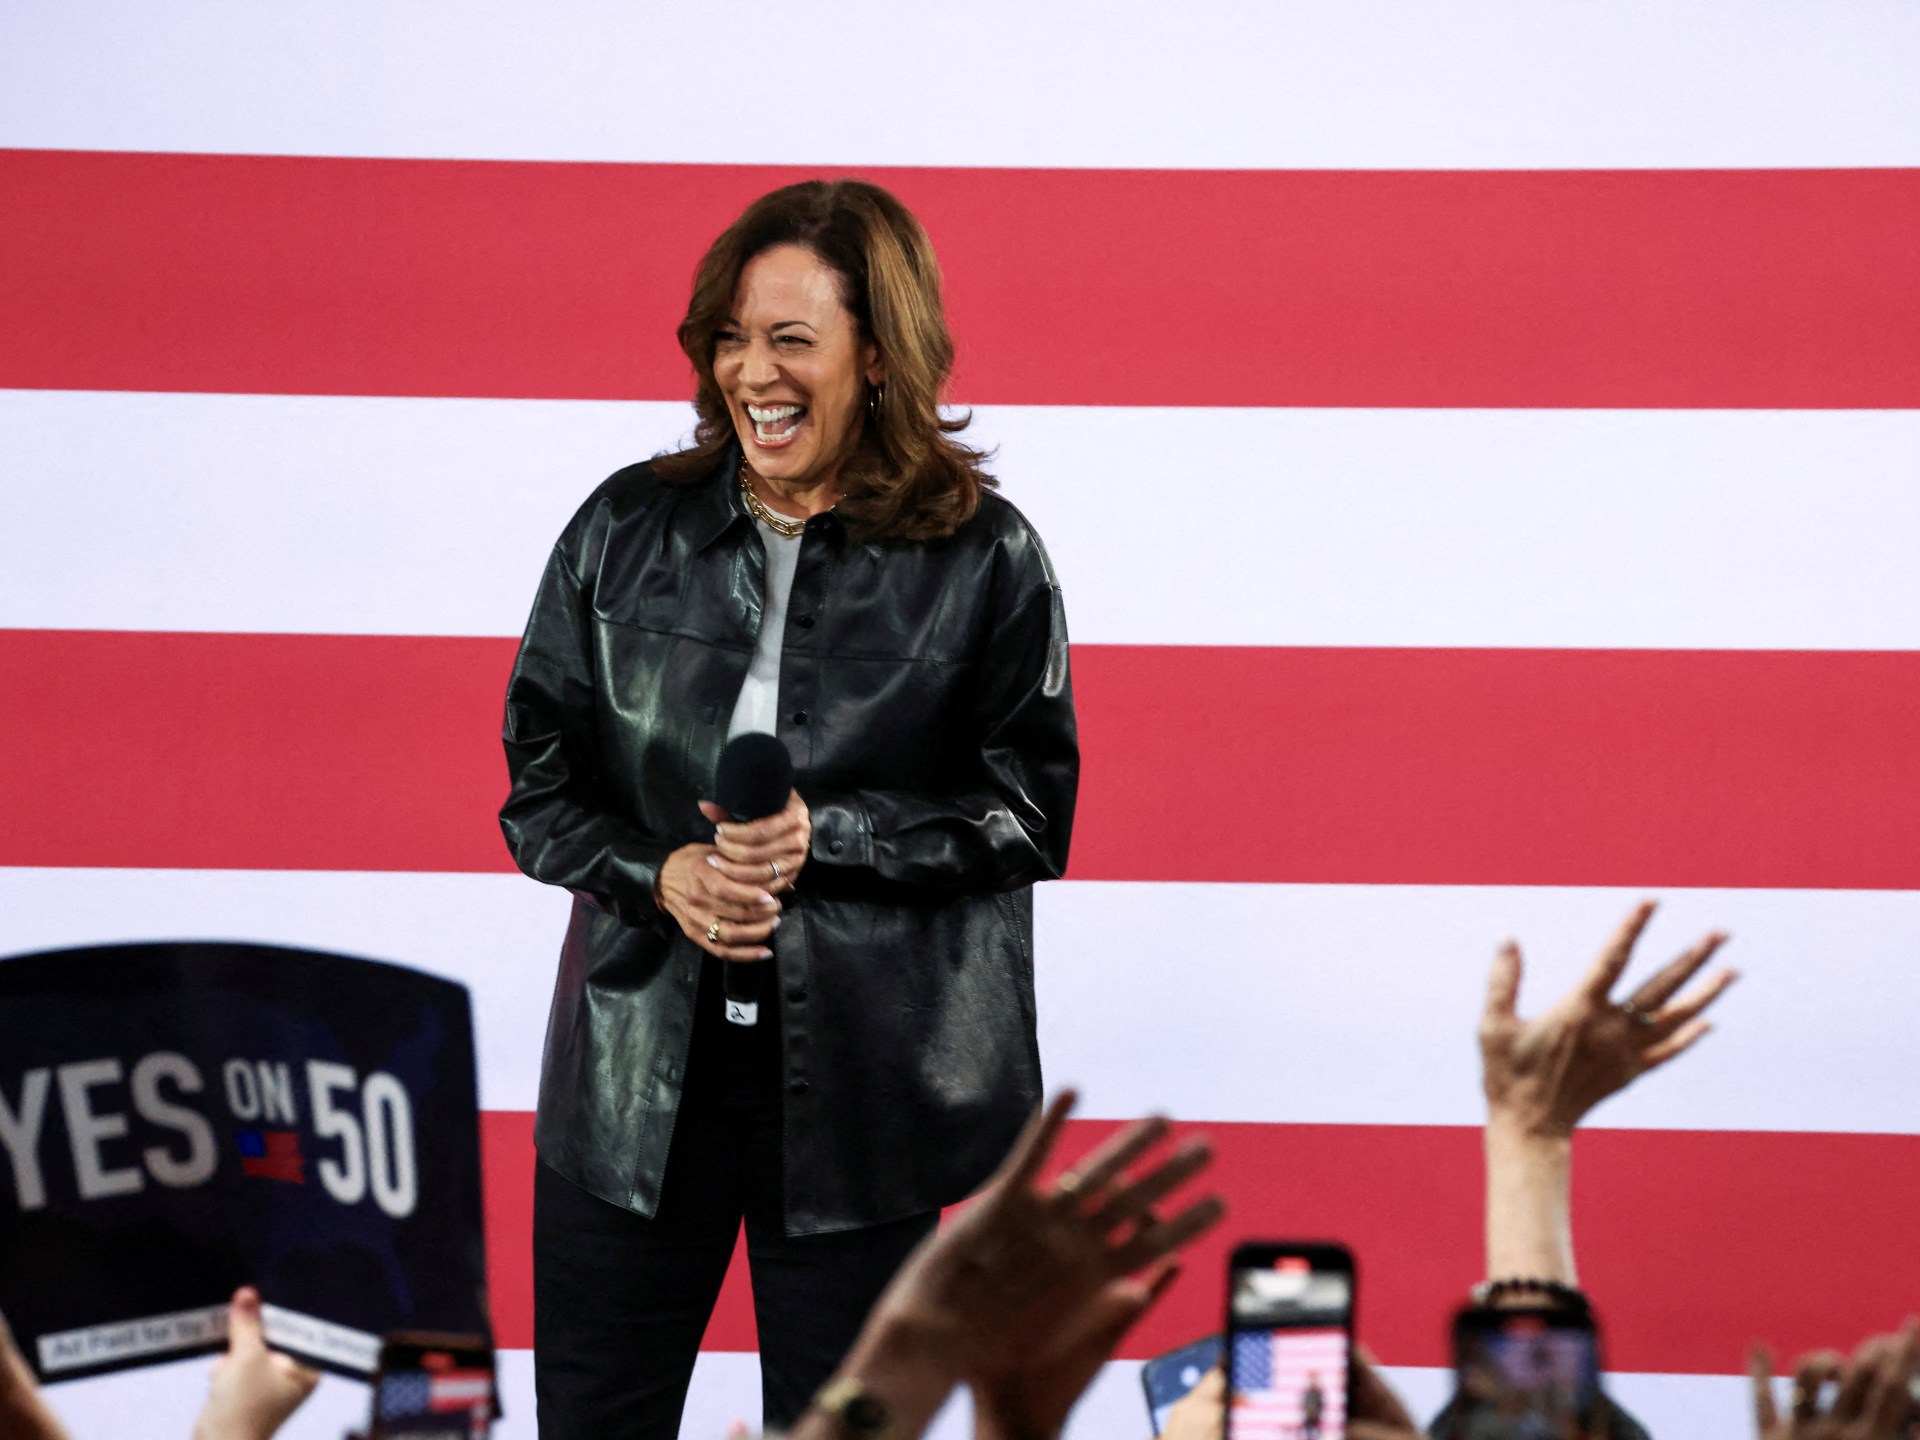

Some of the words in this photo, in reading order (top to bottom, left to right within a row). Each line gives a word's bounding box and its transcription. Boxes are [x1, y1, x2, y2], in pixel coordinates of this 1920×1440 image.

[0, 1052, 218, 1211] YES
[223, 1057, 297, 1125] ON
[305, 1058, 418, 1219] 50
